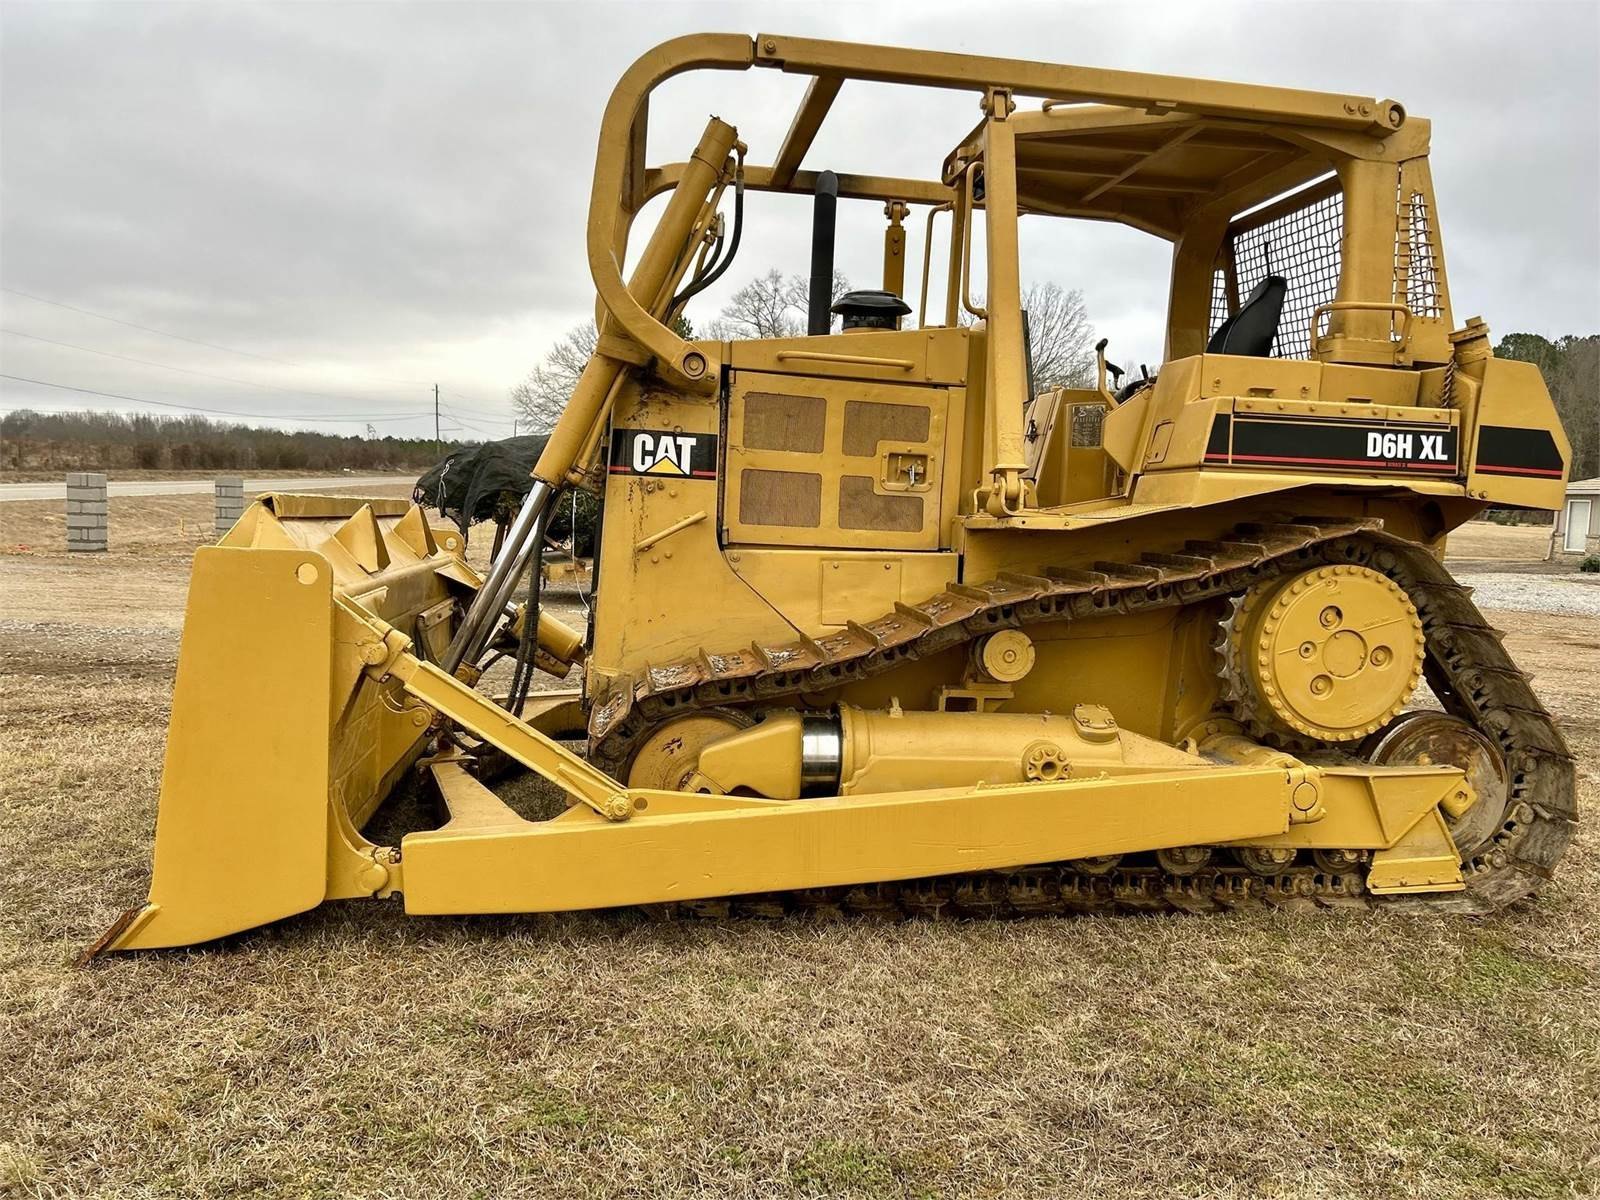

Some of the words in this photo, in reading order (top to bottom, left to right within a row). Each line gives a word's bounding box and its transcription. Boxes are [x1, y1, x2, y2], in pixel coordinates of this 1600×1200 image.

[633, 433, 697, 475] CAT
[1367, 432, 1413, 459] D6H
[1419, 435, 1448, 460] XL
